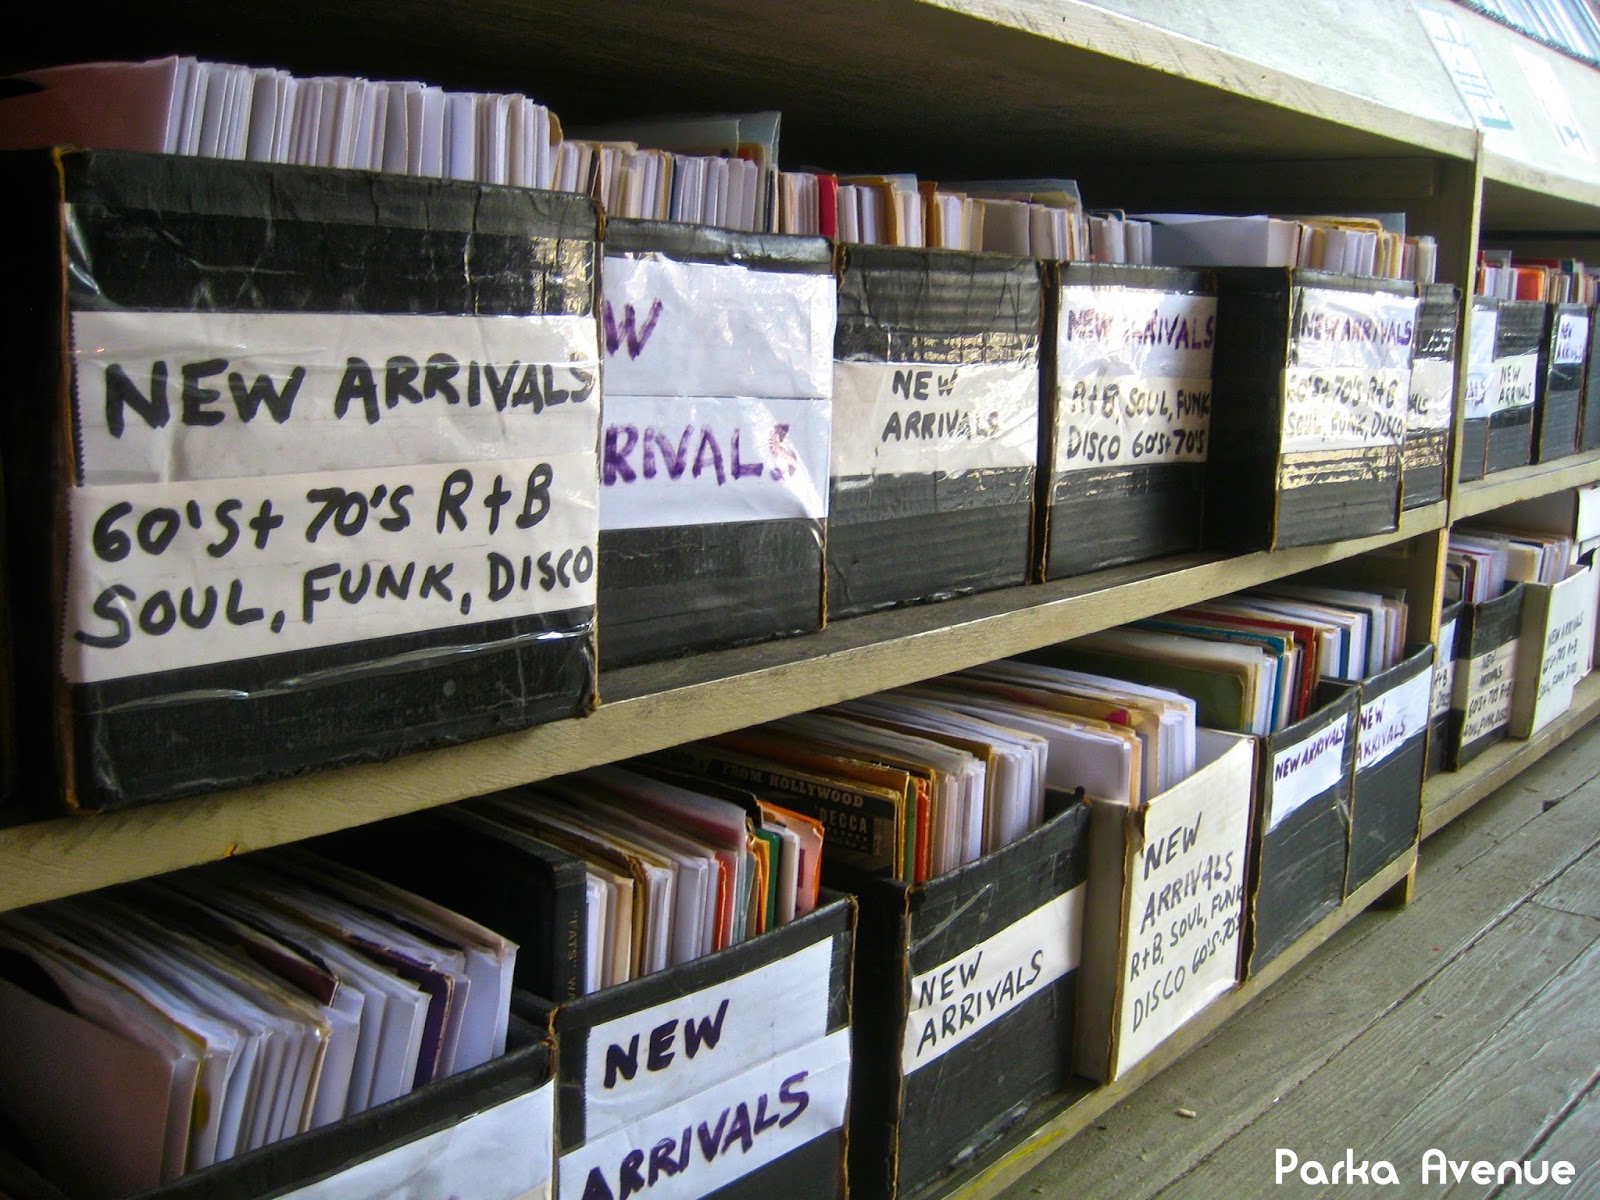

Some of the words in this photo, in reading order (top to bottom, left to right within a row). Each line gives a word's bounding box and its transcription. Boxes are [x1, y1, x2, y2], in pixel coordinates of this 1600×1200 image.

[1301, 311, 1339, 341] NEW
[1340, 316, 1412, 346] ARRIVALS
[105, 359, 306, 438] NEW
[334, 352, 594, 425] ARRIVALS
[892, 369, 957, 401] NEW
[881, 410, 1000, 444] ARRIVALS
[1066, 425, 1122, 464] DISCO
[305, 484, 414, 543] 70'S
[74, 578, 284, 649] SOUL,
[302, 561, 472, 624] FUNK,
[486, 546, 594, 601] DISCO
[1356, 714, 1407, 764] ARRIVALS
[1360, 699, 1386, 732] NEW
[1275, 752, 1301, 783] NEW
[1301, 722, 1346, 768] ARRIVALS
[720, 762, 763, 787] FROM
[769, 774, 865, 809] HOLLYWOOD
[819, 807, 868, 833] DECCA
[1143, 811, 1202, 881] NEW
[1140, 850, 1234, 935] ARRIVALS
[916, 949, 1045, 1058] ARRIVALS
[917, 949, 984, 1010] NEW
[1132, 965, 1186, 1034] DISCO
[603, 998, 731, 1090] NEW
[580, 1070, 810, 1200] ARRIVALS
